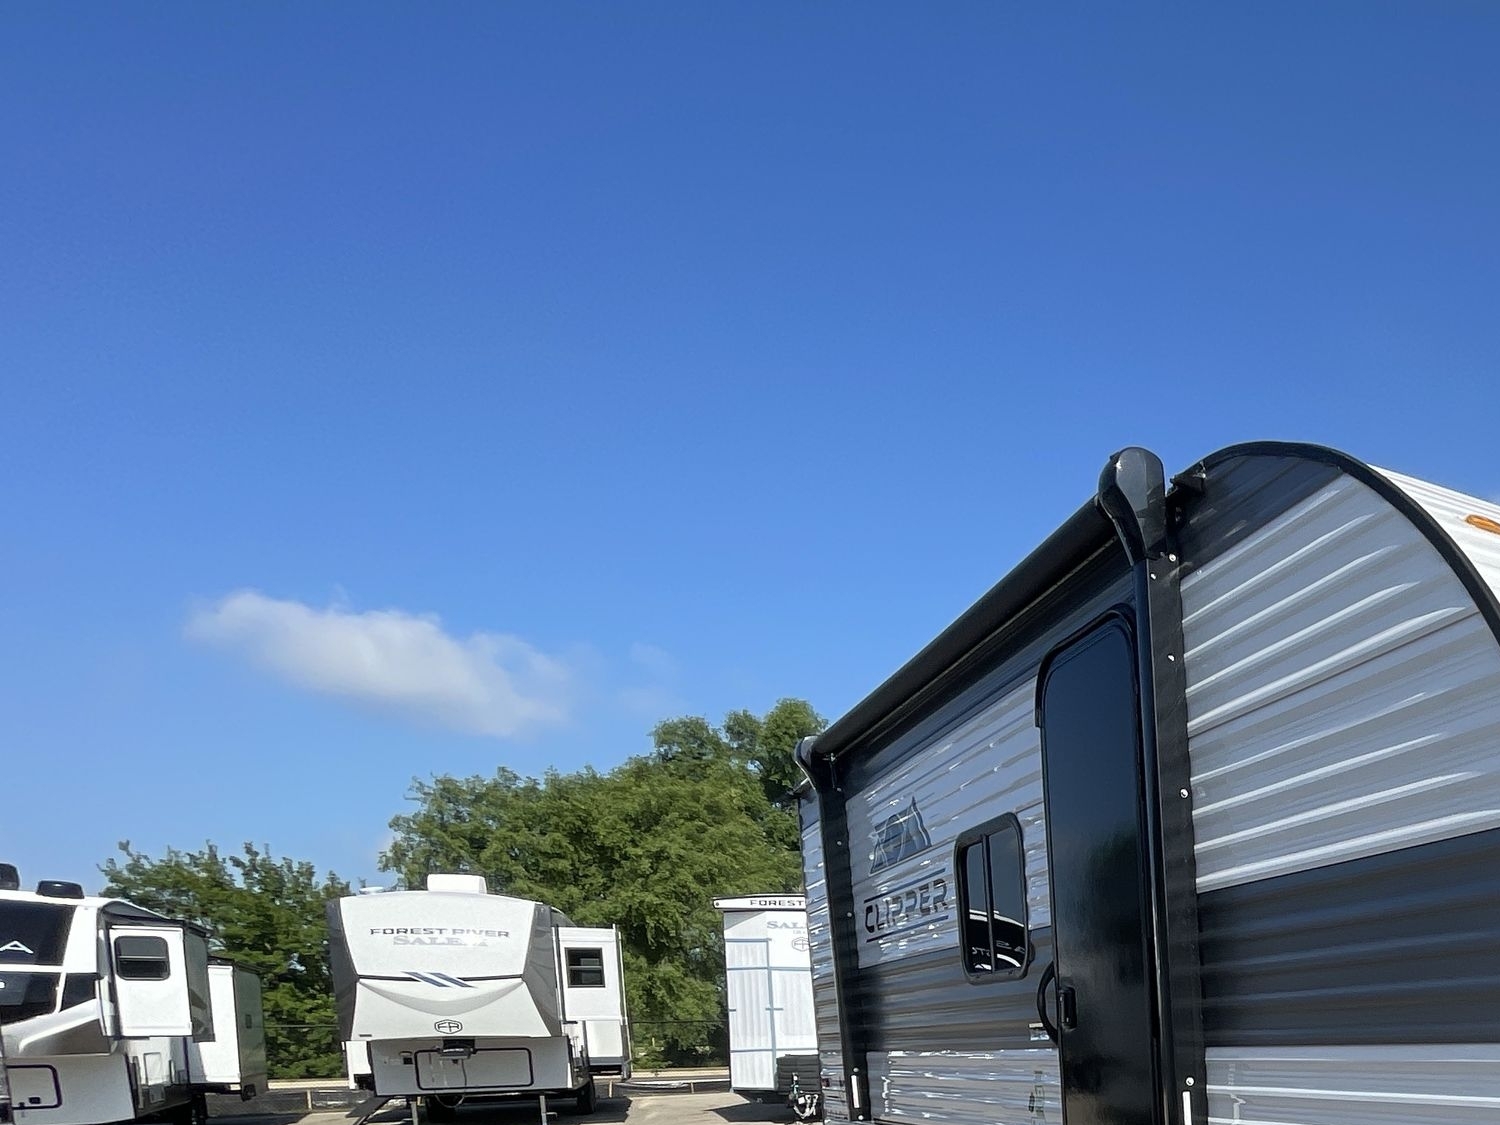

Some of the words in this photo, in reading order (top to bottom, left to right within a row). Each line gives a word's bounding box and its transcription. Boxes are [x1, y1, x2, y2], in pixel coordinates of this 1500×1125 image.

[750, 899, 804, 907] FOREST
[865, 877, 949, 934] CLIPPER
[370, 928, 447, 936] FOREST
[393, 935, 489, 947] SALE
